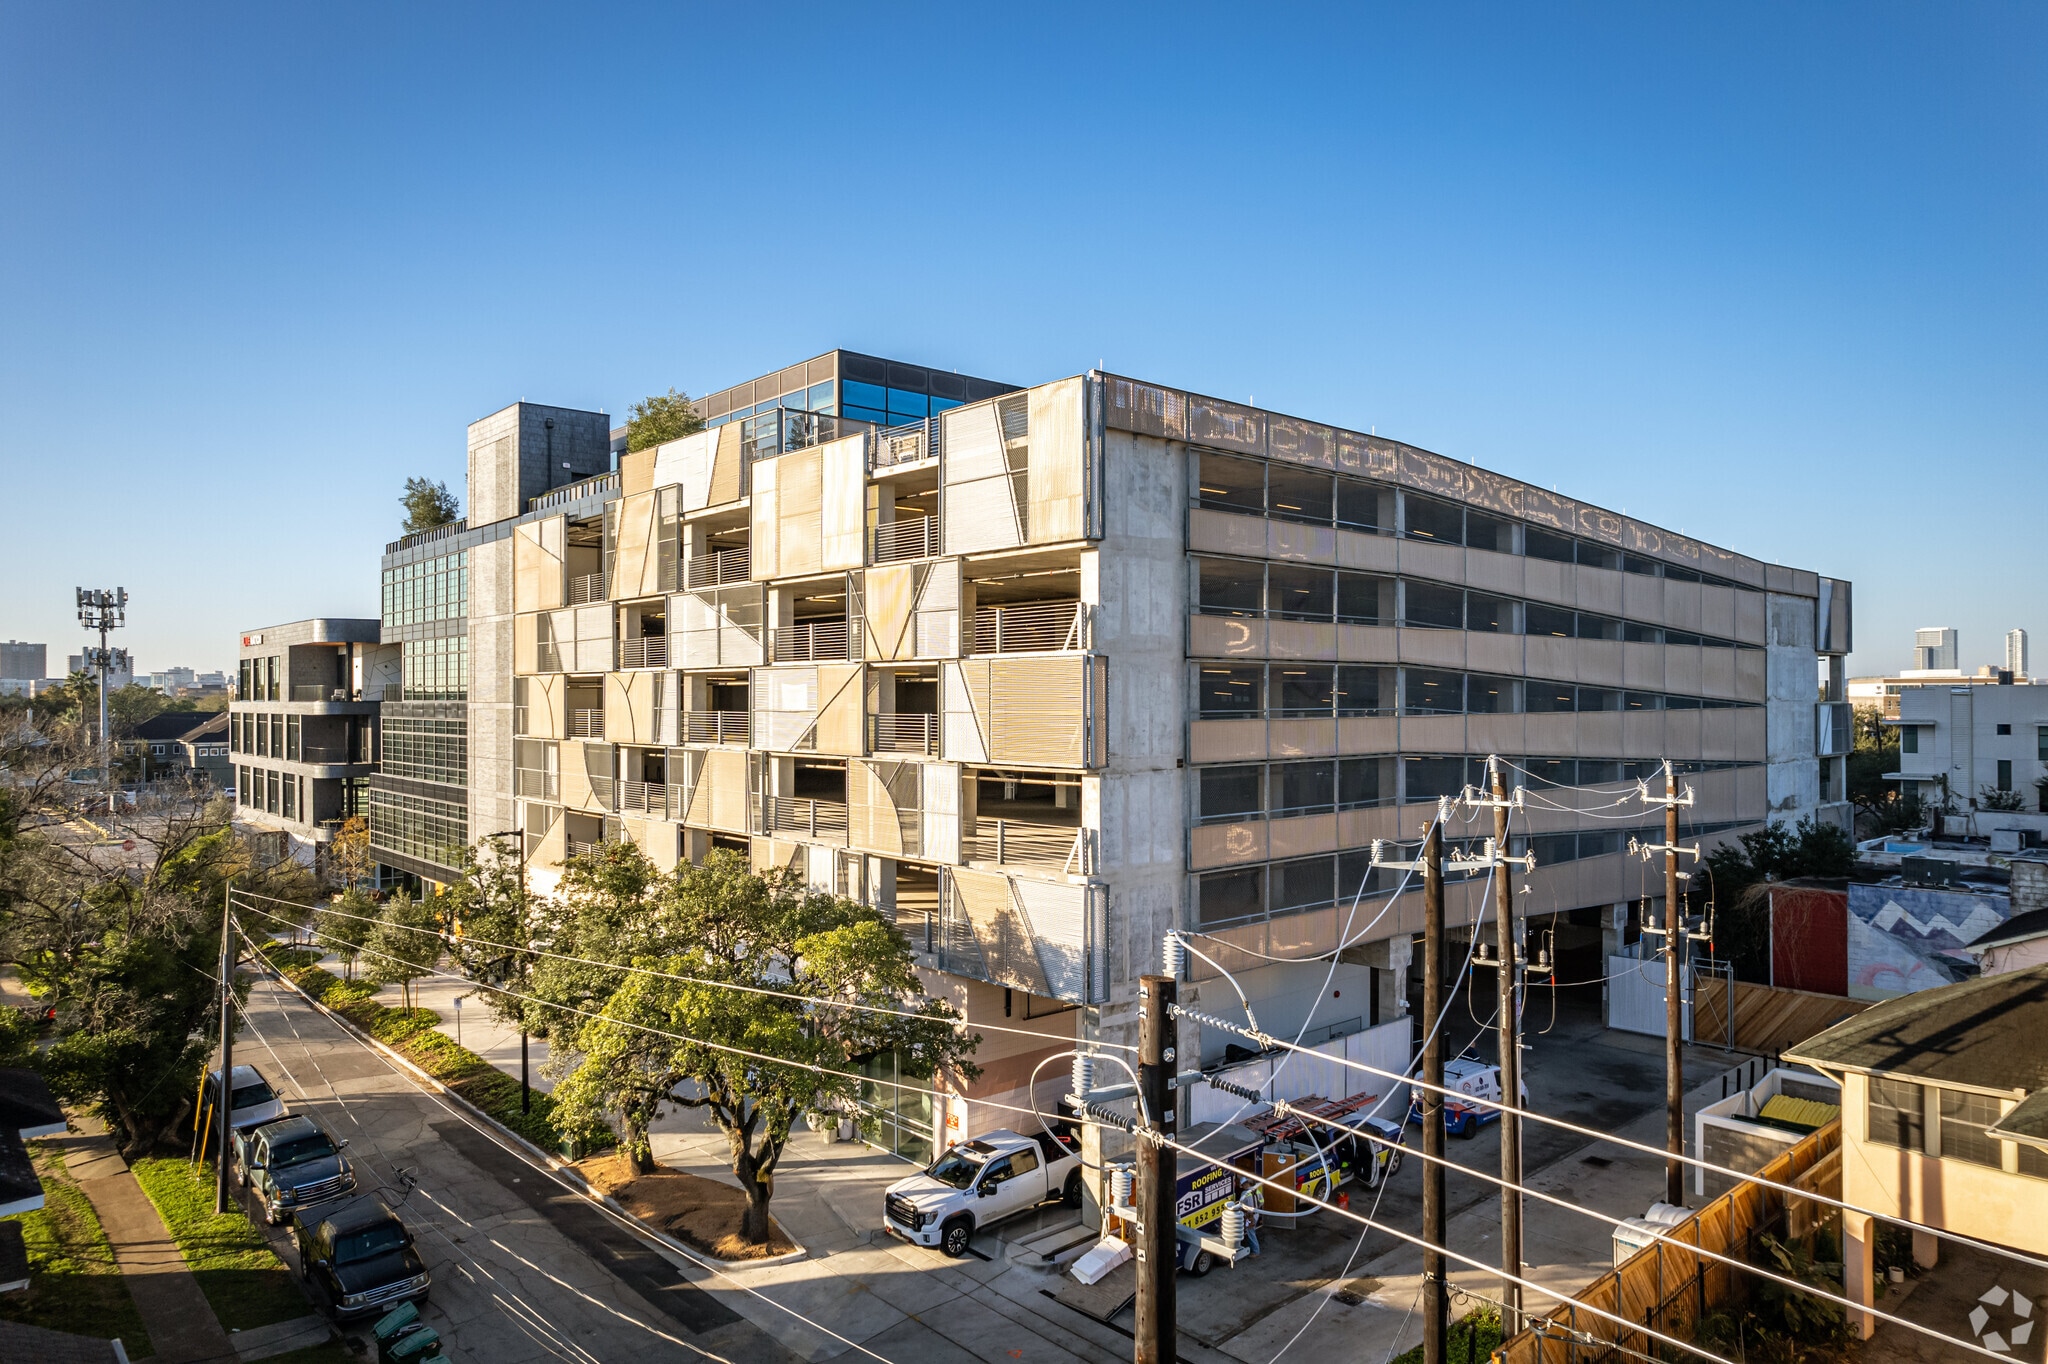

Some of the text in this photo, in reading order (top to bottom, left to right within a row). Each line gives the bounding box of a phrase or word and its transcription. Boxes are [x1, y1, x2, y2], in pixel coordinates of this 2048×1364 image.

[1191, 1168, 1222, 1190] ROOFING
[1204, 1176, 1232, 1193] SERVICES
[1177, 1193, 1201, 1215] FSR
[1194, 1212, 1209, 1225] 852
